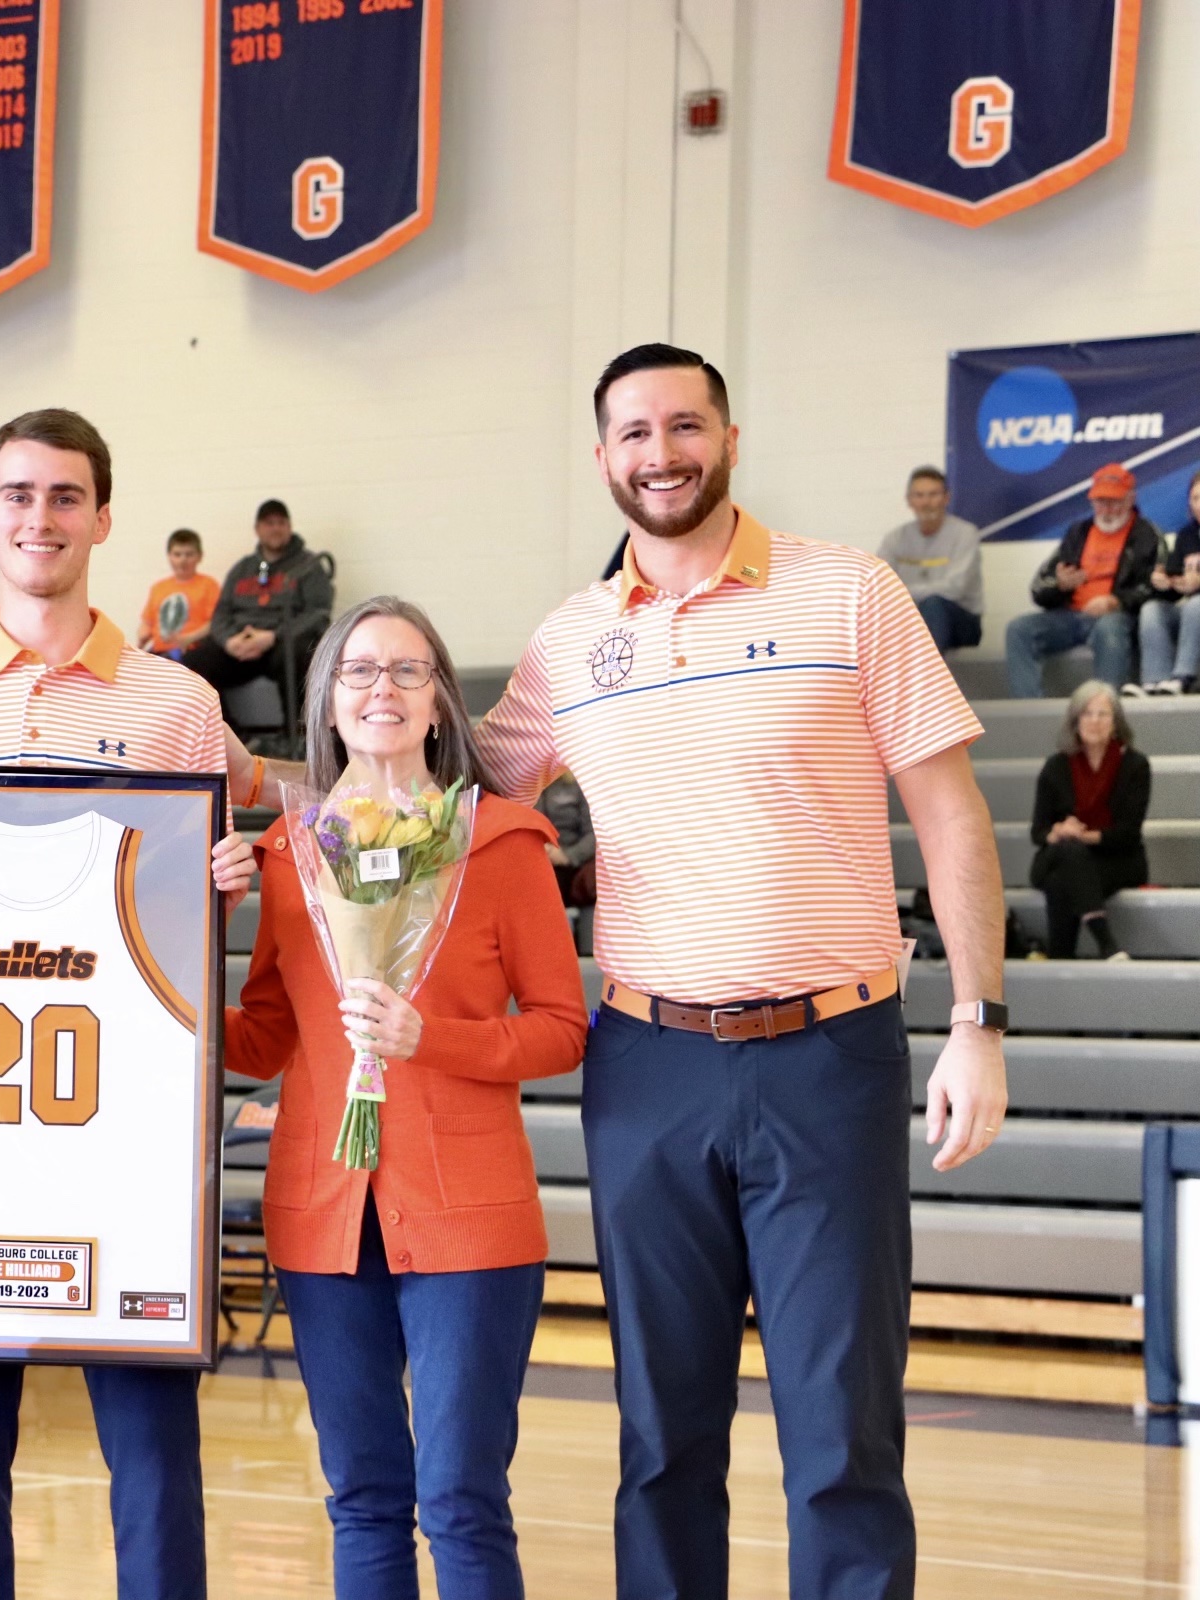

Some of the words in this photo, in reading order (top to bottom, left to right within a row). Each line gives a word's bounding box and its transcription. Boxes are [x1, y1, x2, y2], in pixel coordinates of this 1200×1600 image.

[232, 1, 281, 33] 1994
[230, 32, 282, 65] 2019
[948, 75, 1014, 169] G
[292, 156, 344, 241] G
[986, 412, 1164, 449] NCAA.com
[5, 1263, 61, 1278] HILLIARD
[30, 1249, 79, 1260] COLLEGE
[67, 1285, 80, 1302] G
